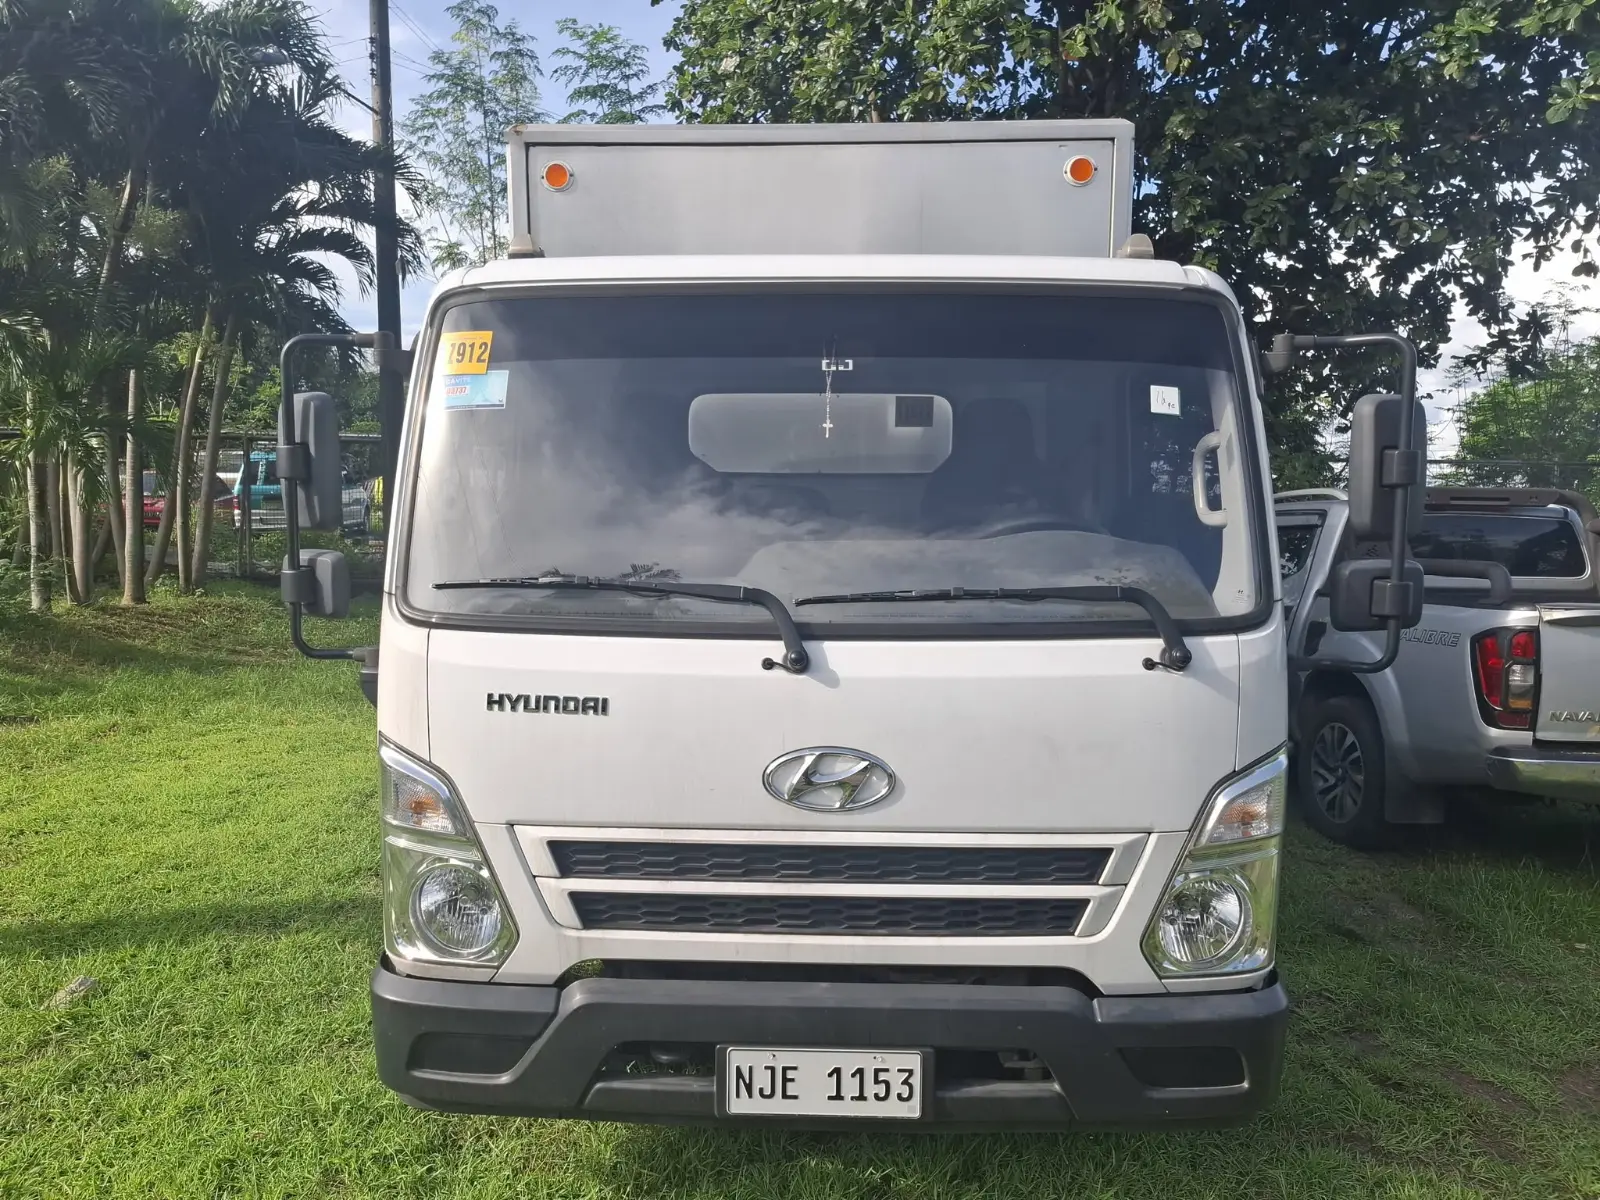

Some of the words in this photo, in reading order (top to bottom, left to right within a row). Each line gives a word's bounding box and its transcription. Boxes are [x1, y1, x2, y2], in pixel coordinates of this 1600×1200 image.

[1400, 627, 1461, 648] ALIBRE
[486, 692, 610, 716] HYUNDAI
[734, 1065, 799, 1100] NJE
[826, 1066, 914, 1102] 1153
